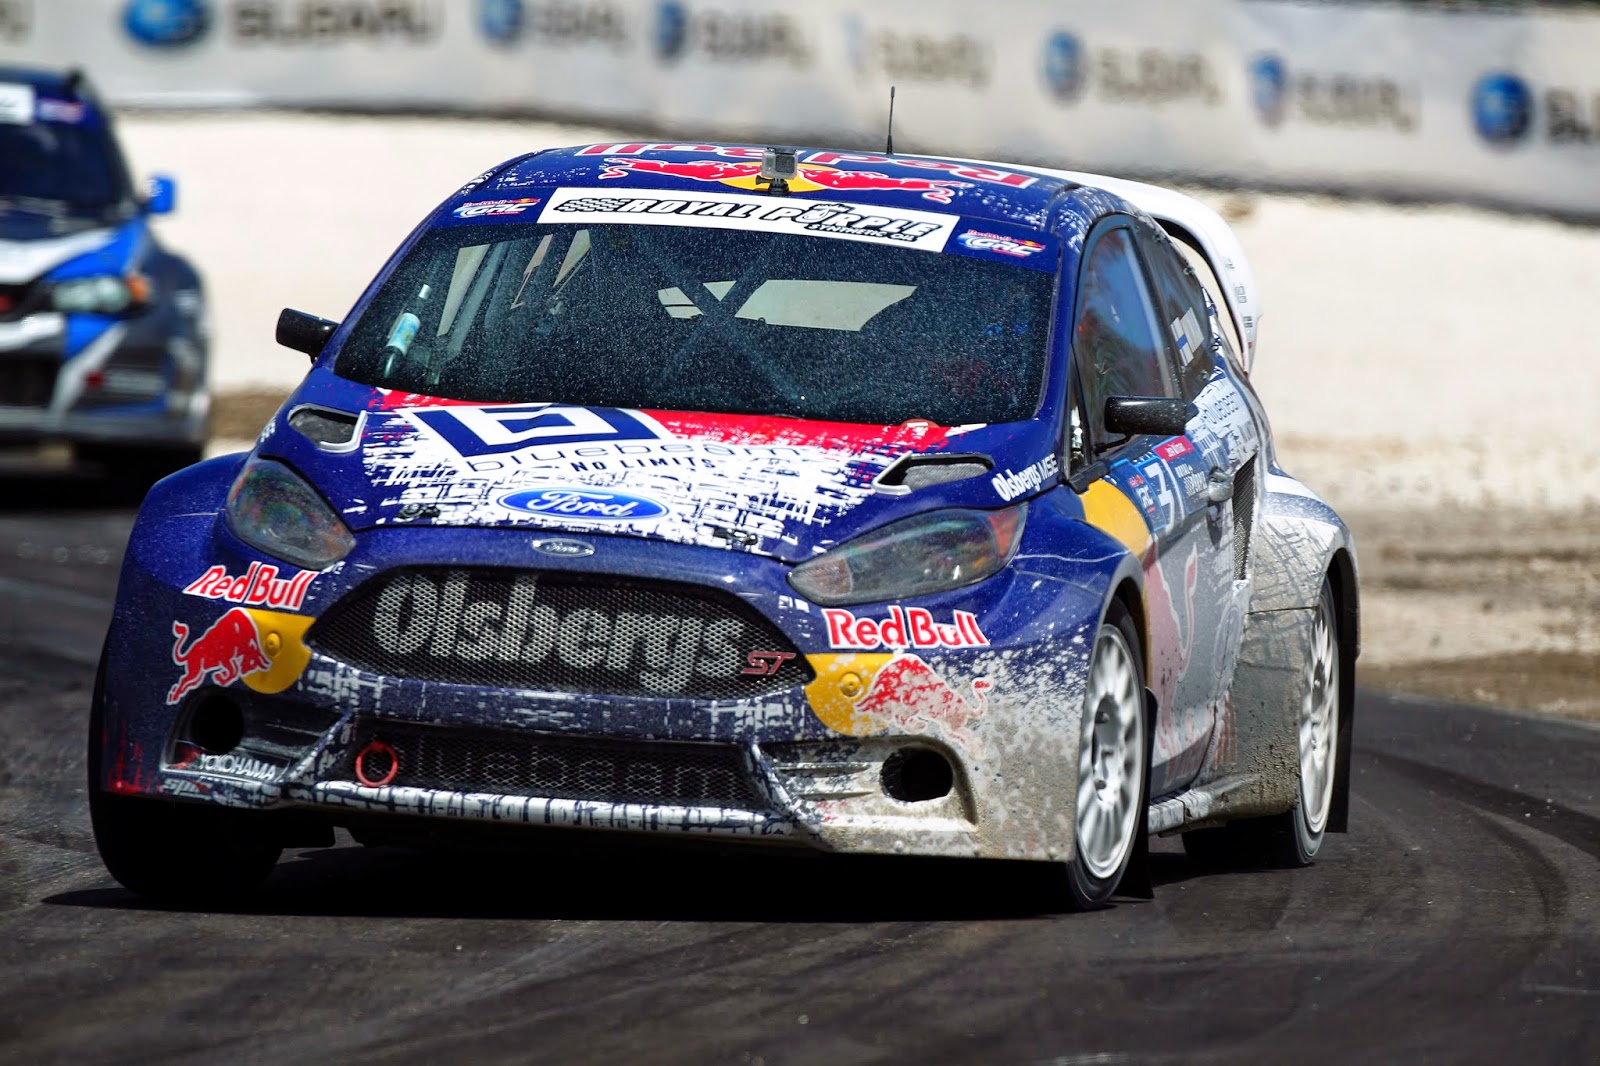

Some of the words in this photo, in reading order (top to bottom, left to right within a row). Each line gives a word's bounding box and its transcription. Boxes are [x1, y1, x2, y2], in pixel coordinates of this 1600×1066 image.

[615, 198, 762, 218] ROYAL
[759, 204, 944, 237] PURPLE
[804, 223, 887, 238] SYNTHETIC
[888, 232, 918, 242] OIL
[467, 442, 801, 473] bluebeam
[571, 461, 606, 472] NO
[624, 456, 715, 470] LIMITS
[992, 468, 1041, 502] Olsbergs
[1037, 453, 1059, 480] MSE
[527, 490, 635, 517] Ford
[182, 561, 262, 602] Red
[245, 564, 320, 611] Bull
[372, 568, 746, 693] Olsbergs
[821, 605, 910, 649] Red
[905, 607, 991, 649] Bull
[741, 652, 797, 675] ST
[199, 753, 277, 781] YOKOHAMA
